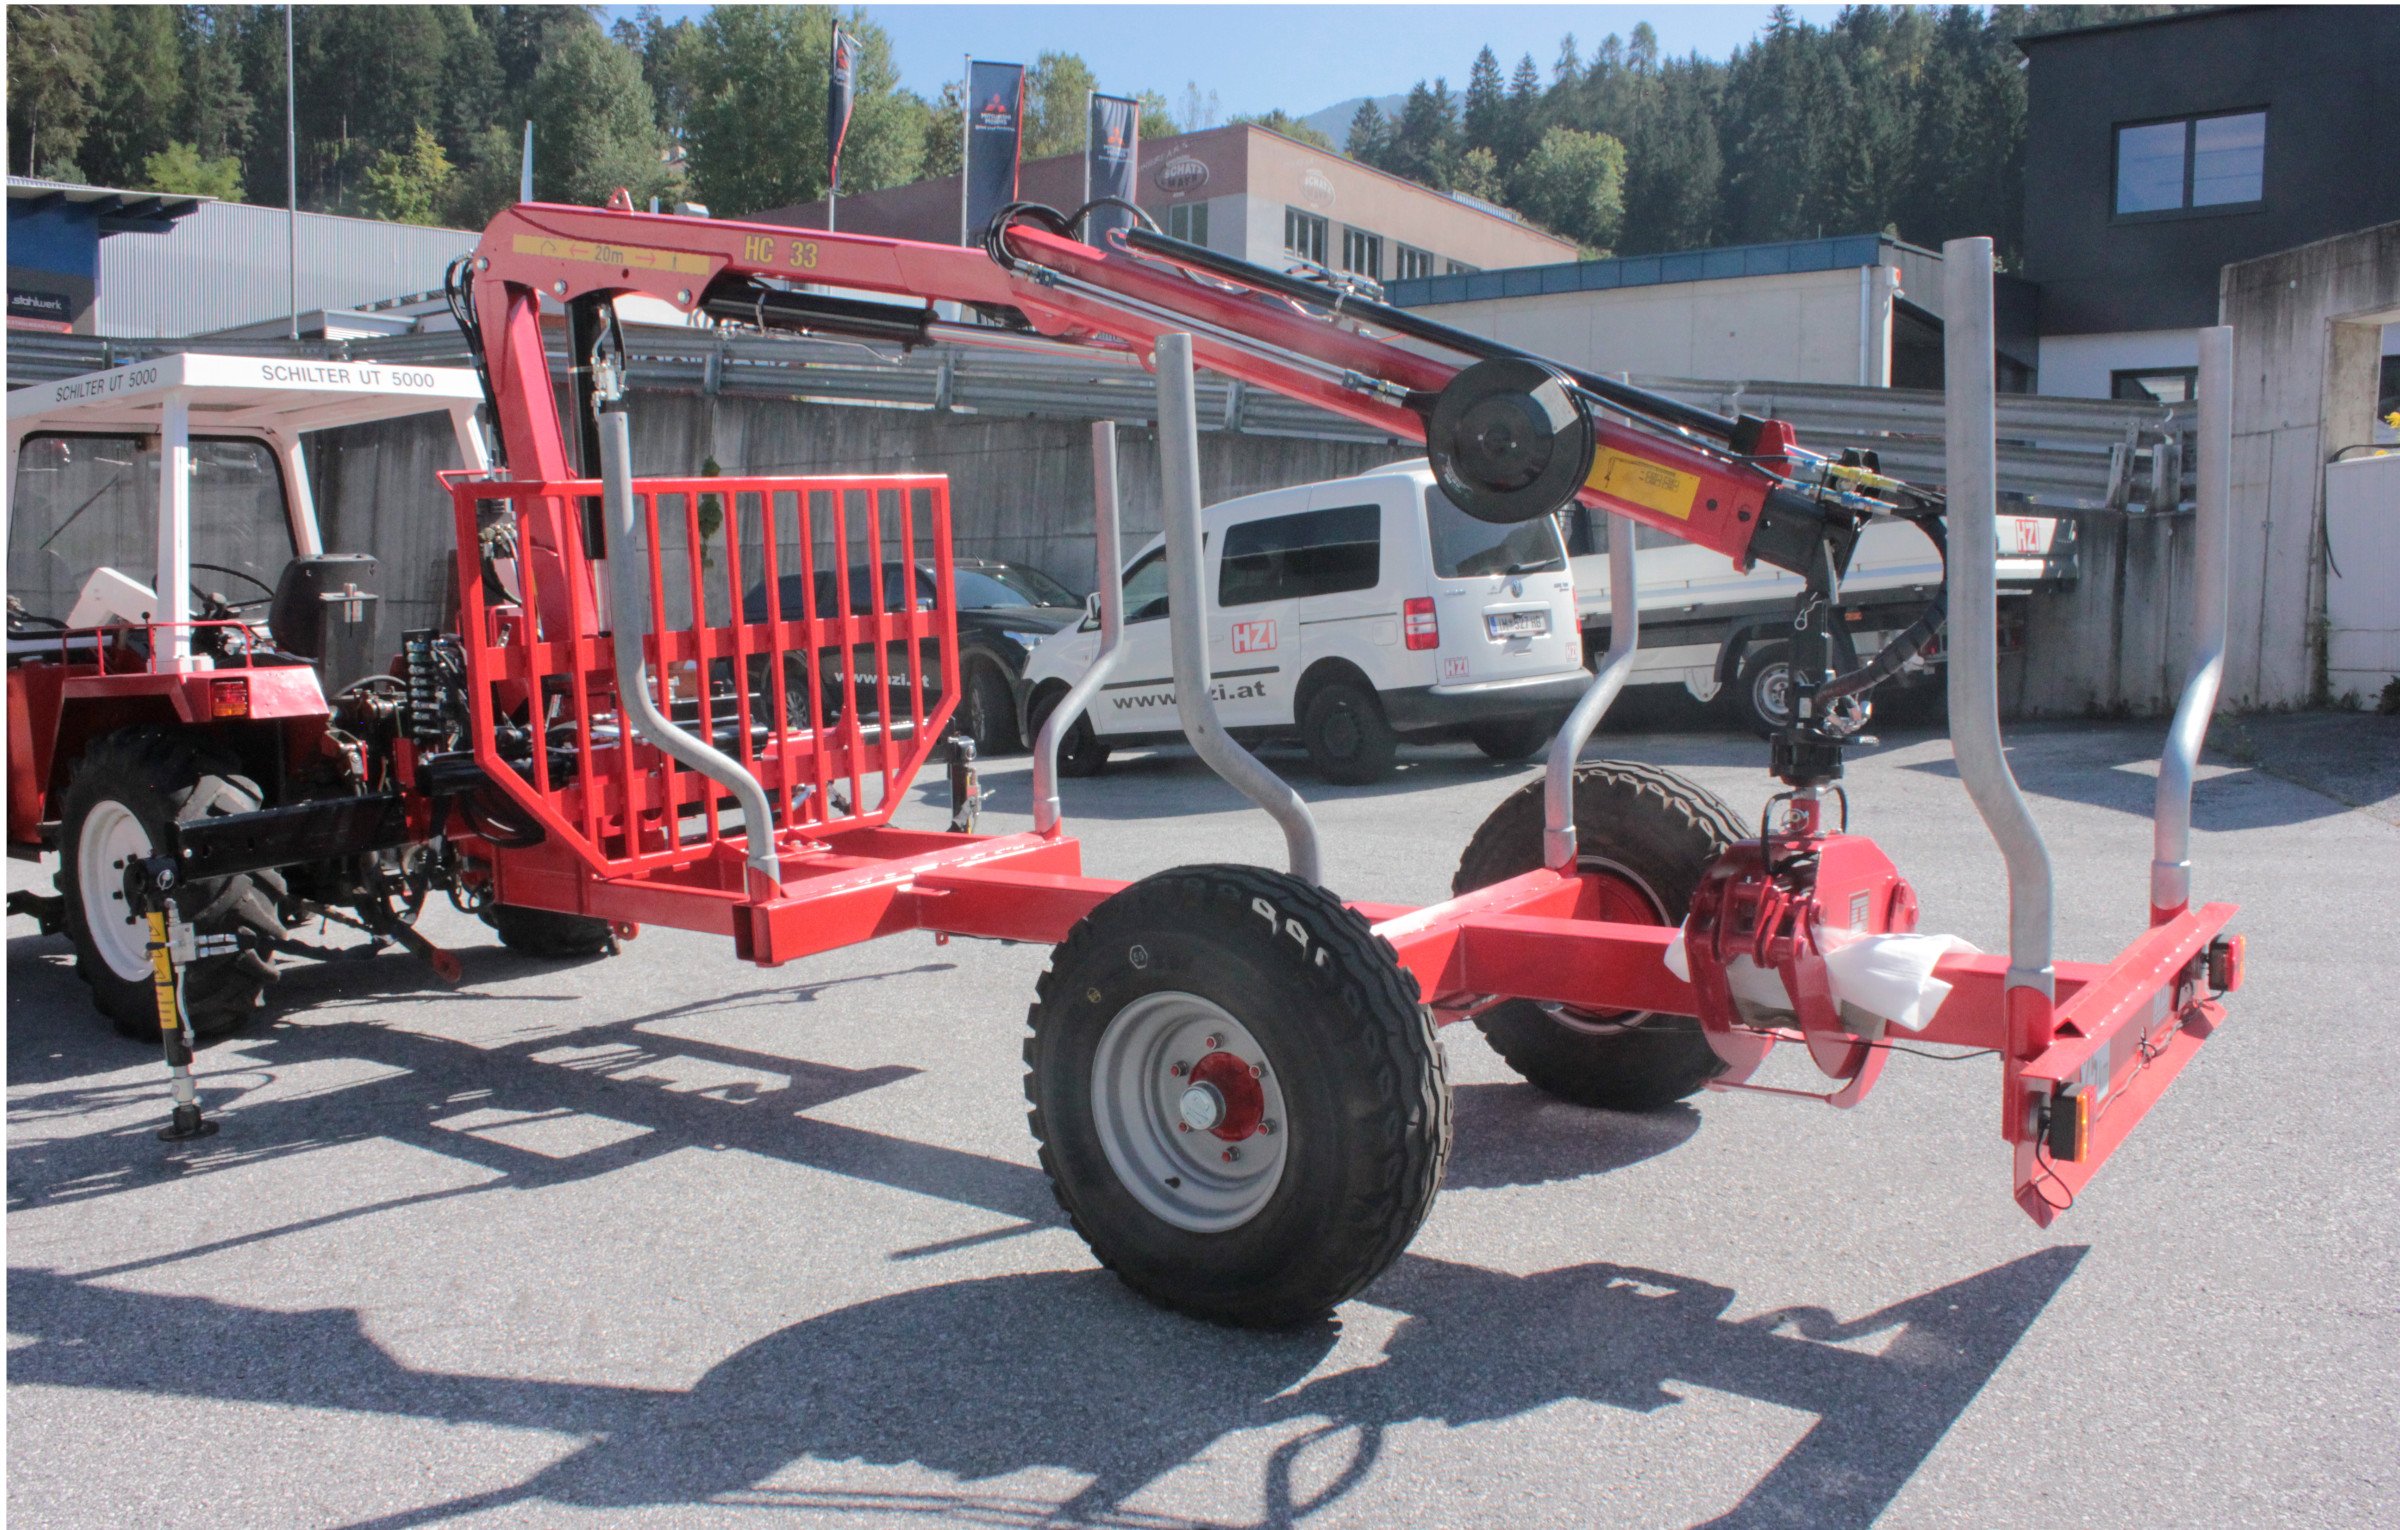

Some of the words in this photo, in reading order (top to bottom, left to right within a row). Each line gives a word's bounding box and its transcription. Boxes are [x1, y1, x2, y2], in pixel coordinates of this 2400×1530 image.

[594, 245, 625, 264] 20m
[744, 235, 774, 264] HC
[789, 240, 819, 269] 33
[56, 378, 105, 403] SCHILTER
[109, 374, 124, 392] UT
[128, 367, 158, 389] 5000
[261, 364, 351, 384] SCHILTER
[358, 370, 381, 386] UT
[391, 371, 435, 389] 5000
[2016, 520, 2039, 553] HZI
[1232, 621, 1278, 654] HZI
